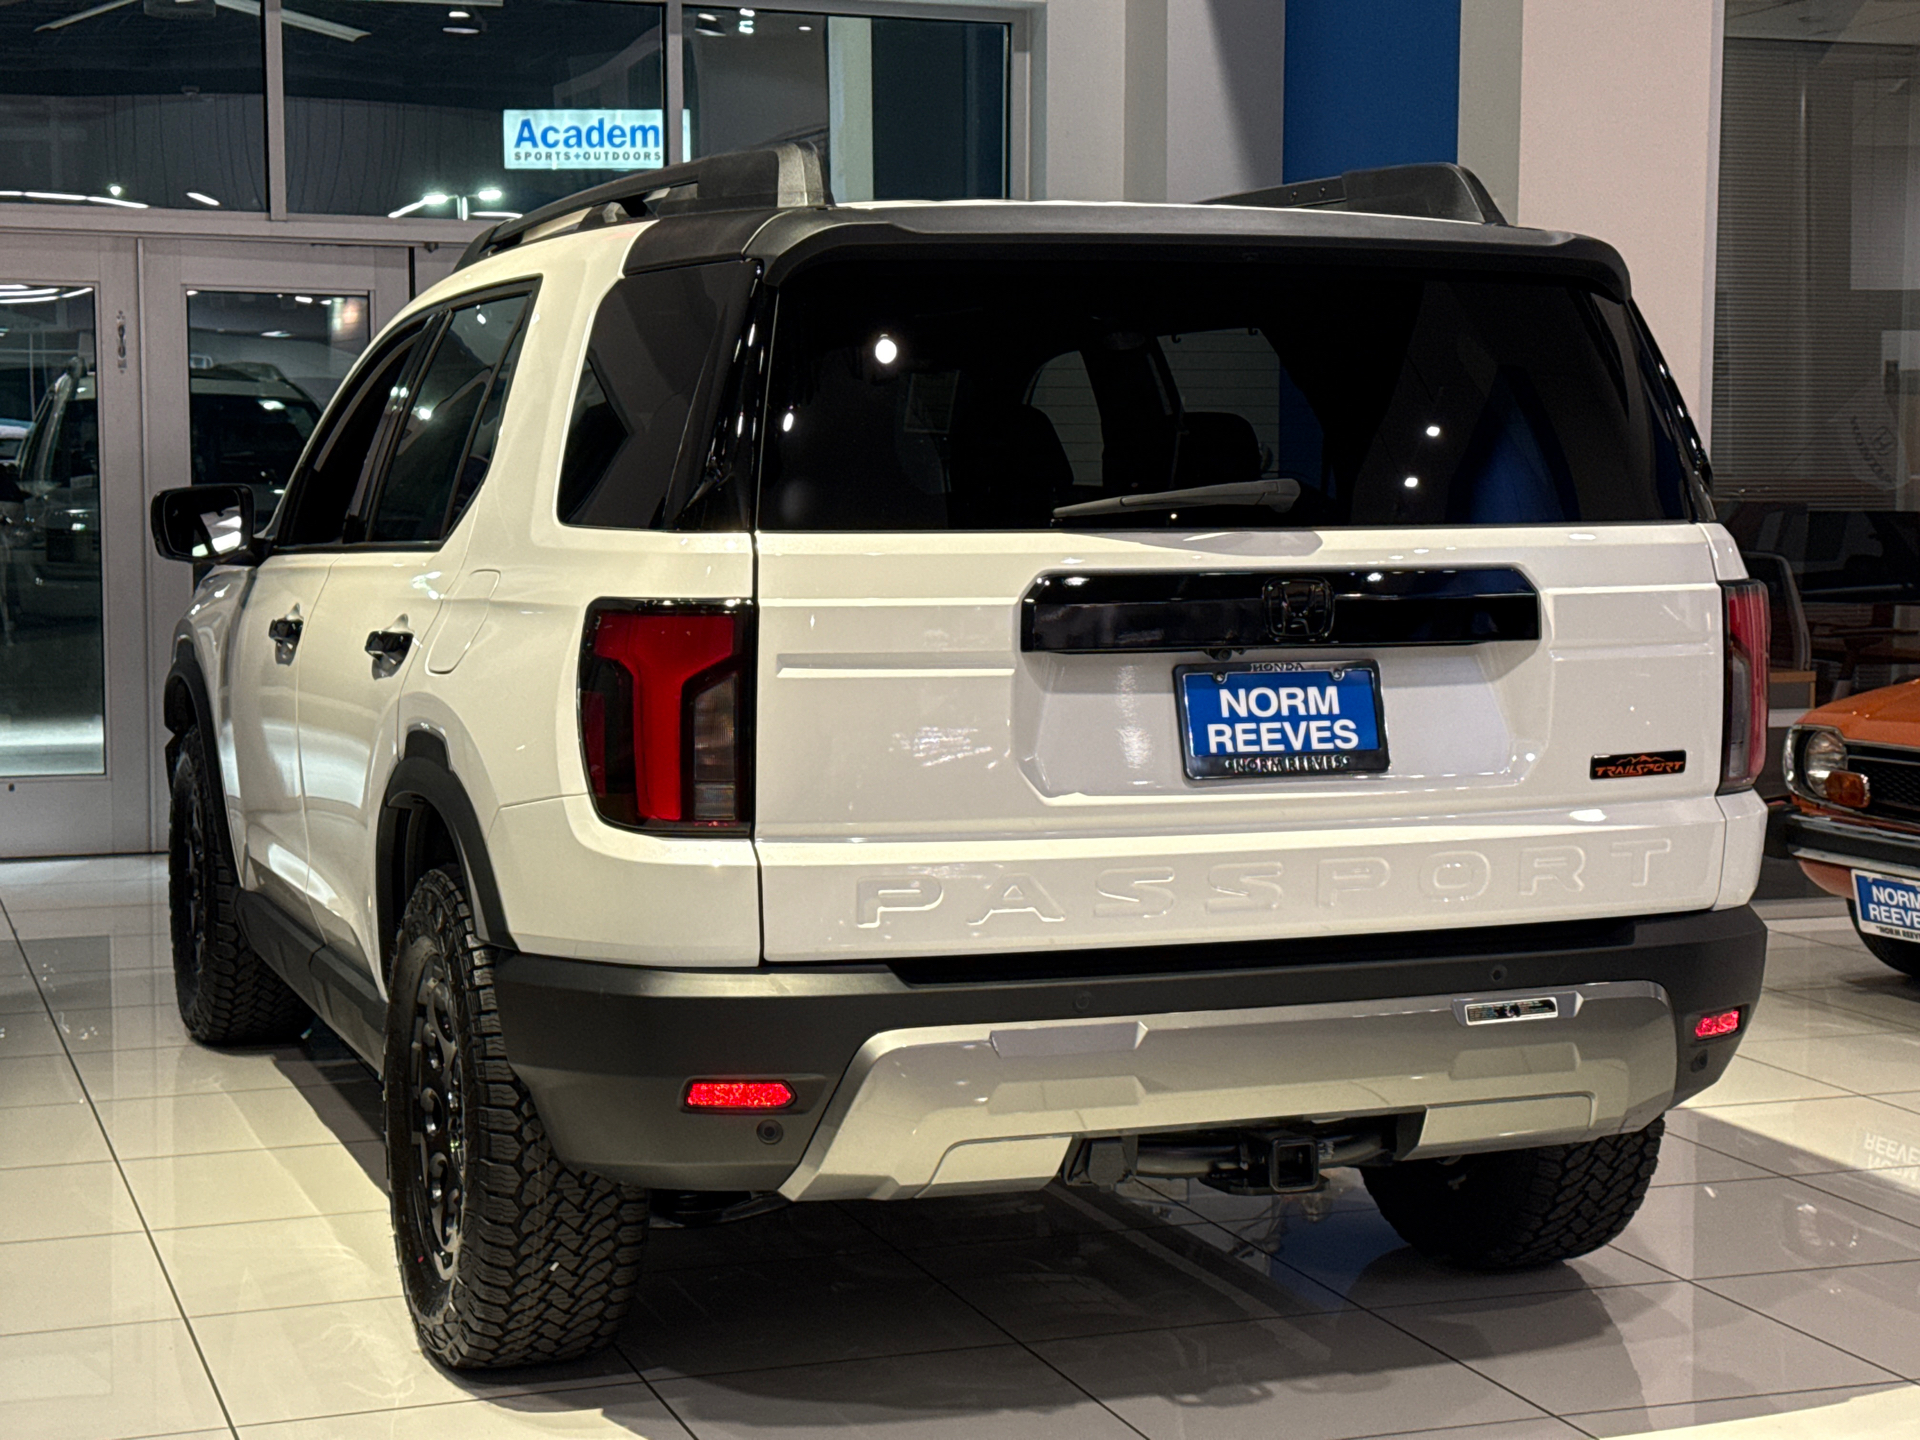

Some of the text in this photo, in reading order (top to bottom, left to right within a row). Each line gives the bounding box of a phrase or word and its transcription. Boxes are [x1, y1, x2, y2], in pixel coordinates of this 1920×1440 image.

[514, 117, 661, 148] Academ
[1252, 662, 1306, 672] HONDA
[1219, 686, 1340, 718] NORM
[1207, 719, 1359, 754] REEVES
[1595, 761, 1684, 777] TRAILSPORT
[856, 838, 1673, 928] PASSPORT
[1868, 903, 1920, 929] REEVE
